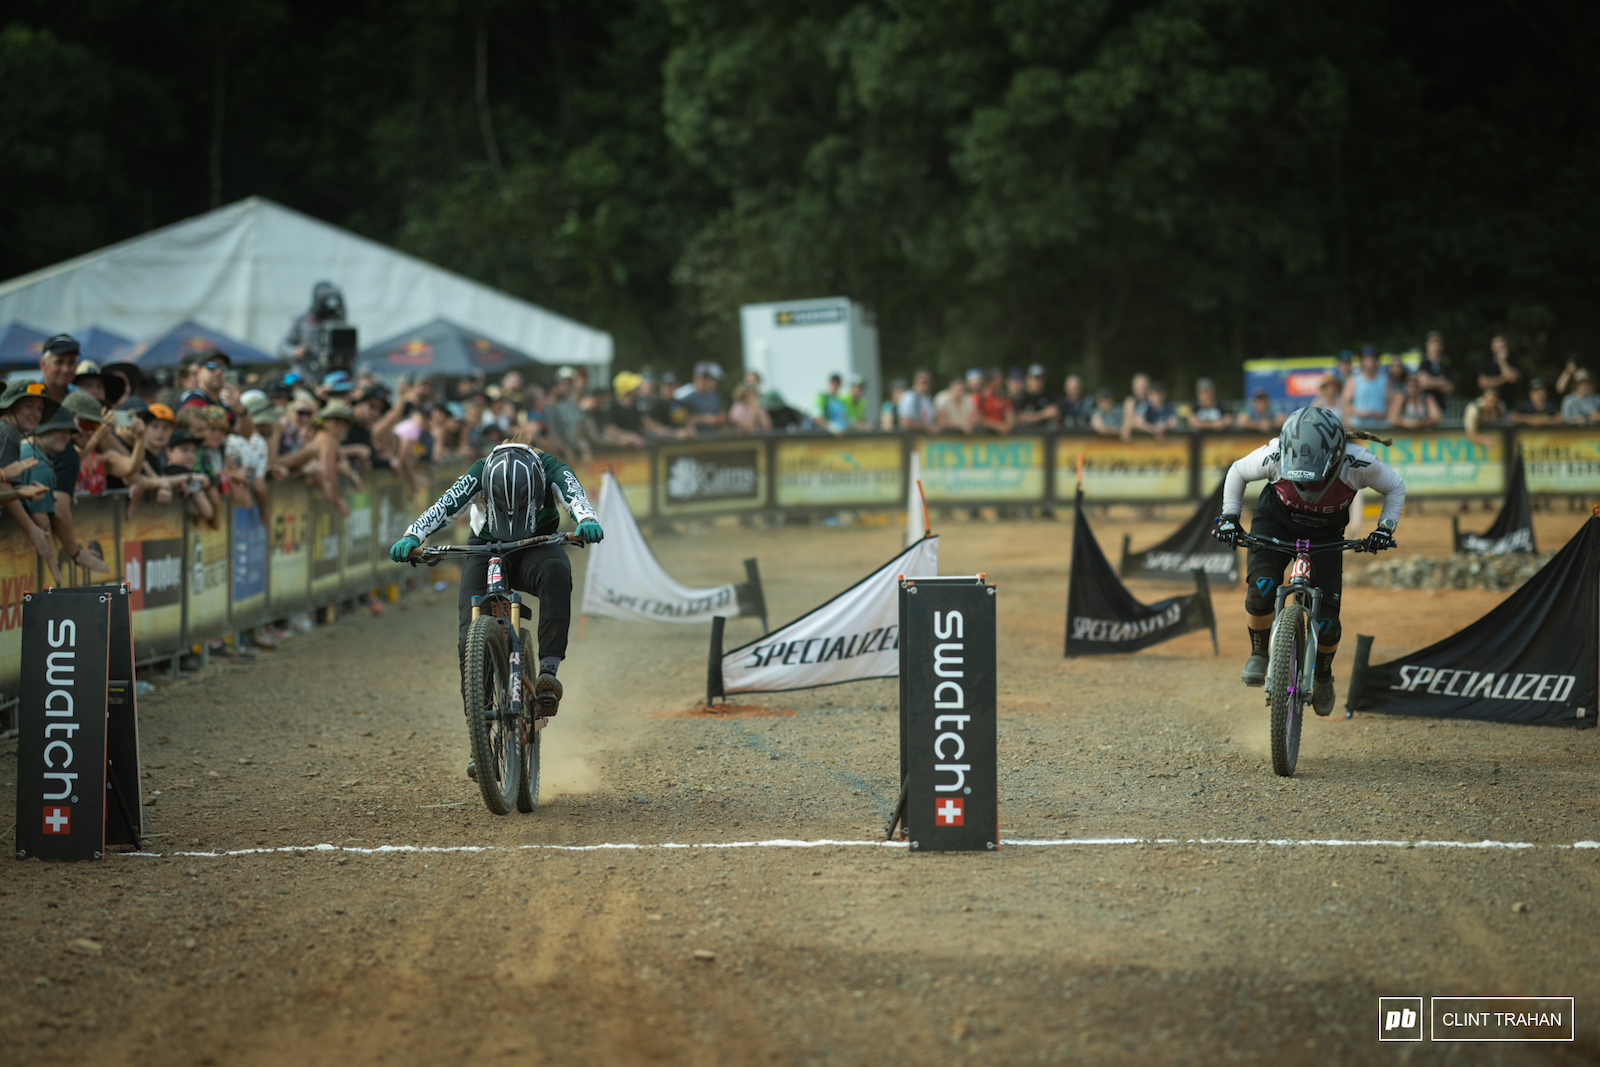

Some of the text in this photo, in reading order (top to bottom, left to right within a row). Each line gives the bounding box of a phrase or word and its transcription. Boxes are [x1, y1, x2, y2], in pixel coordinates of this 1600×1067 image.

[745, 624, 899, 669] SPECIALIZE
[933, 610, 971, 792] swatch
[1390, 664, 1577, 702] SPECIALIZED
[42, 618, 80, 800] swatch
